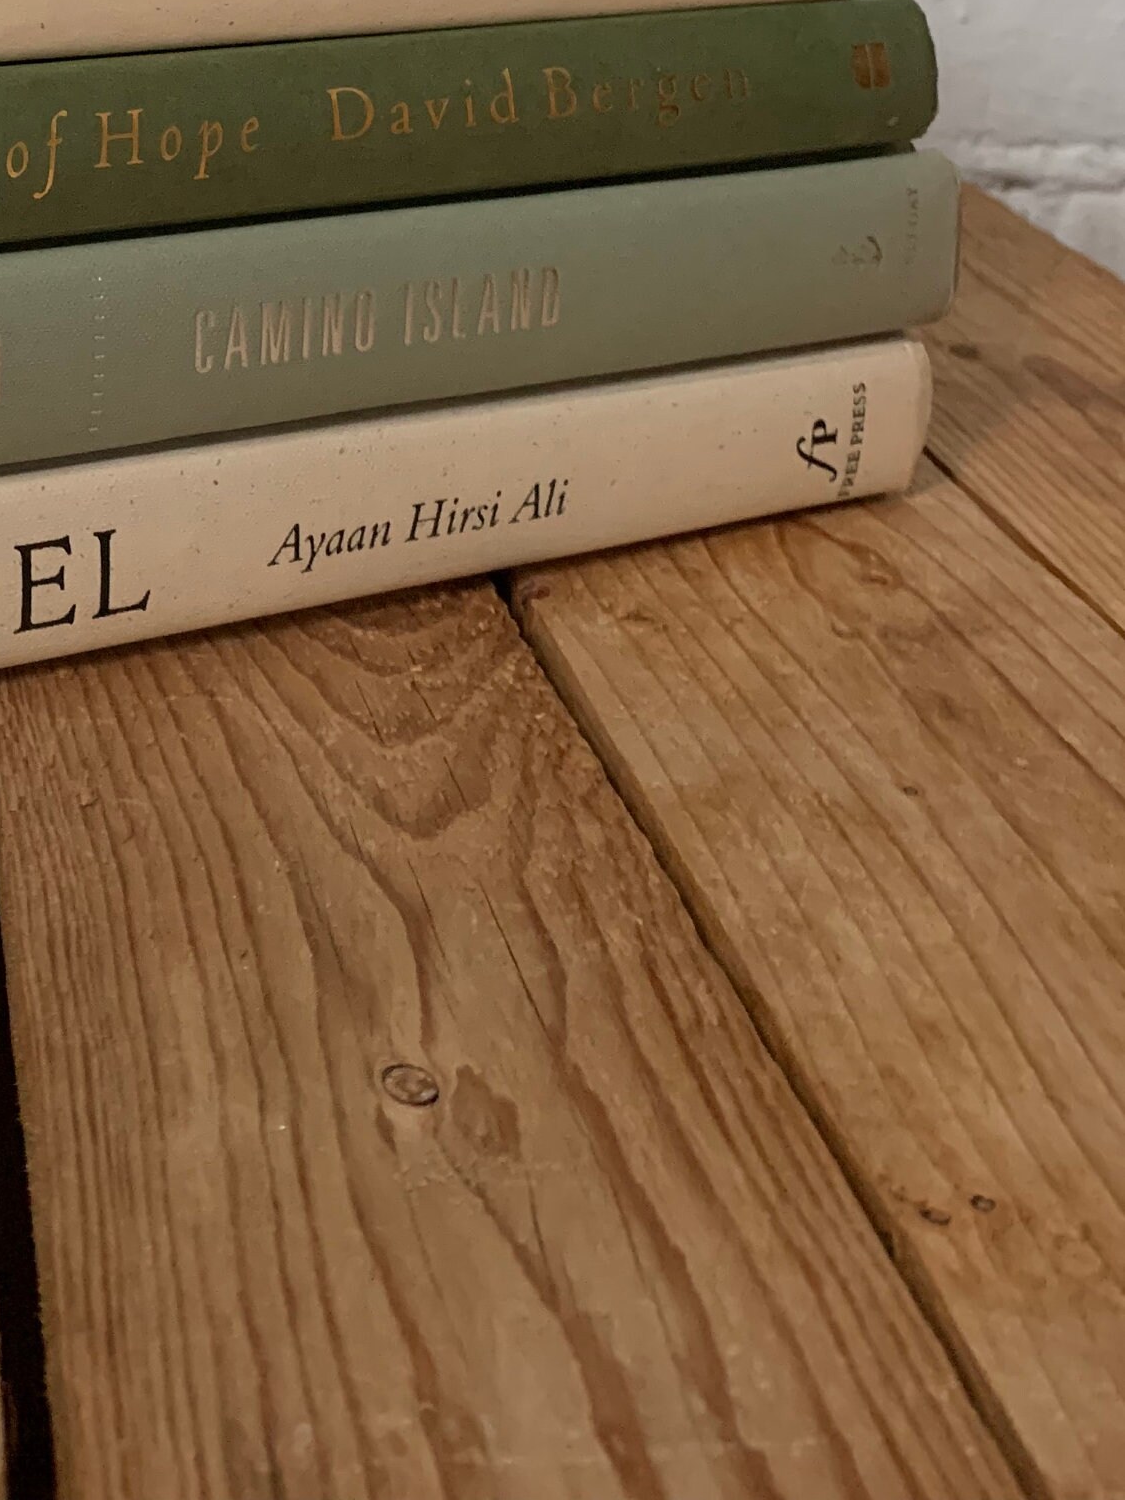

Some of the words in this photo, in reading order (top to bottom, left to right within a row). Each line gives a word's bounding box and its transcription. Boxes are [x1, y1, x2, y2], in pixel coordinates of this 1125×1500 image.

[326, 66, 519, 142] David
[542, 66, 752, 129] Bergen
[6, 110, 68, 199] of
[95, 108, 260, 180] Hope
[194, 289, 375, 374] CAMINO
[403, 265, 561, 347] ISLAND
[849, 382, 868, 446] PRESS
[837, 449, 862, 497] FREE
[267, 520, 392, 575] Ayaan
[404, 490, 503, 544] Hirsi
[508, 478, 570, 525] Ali
